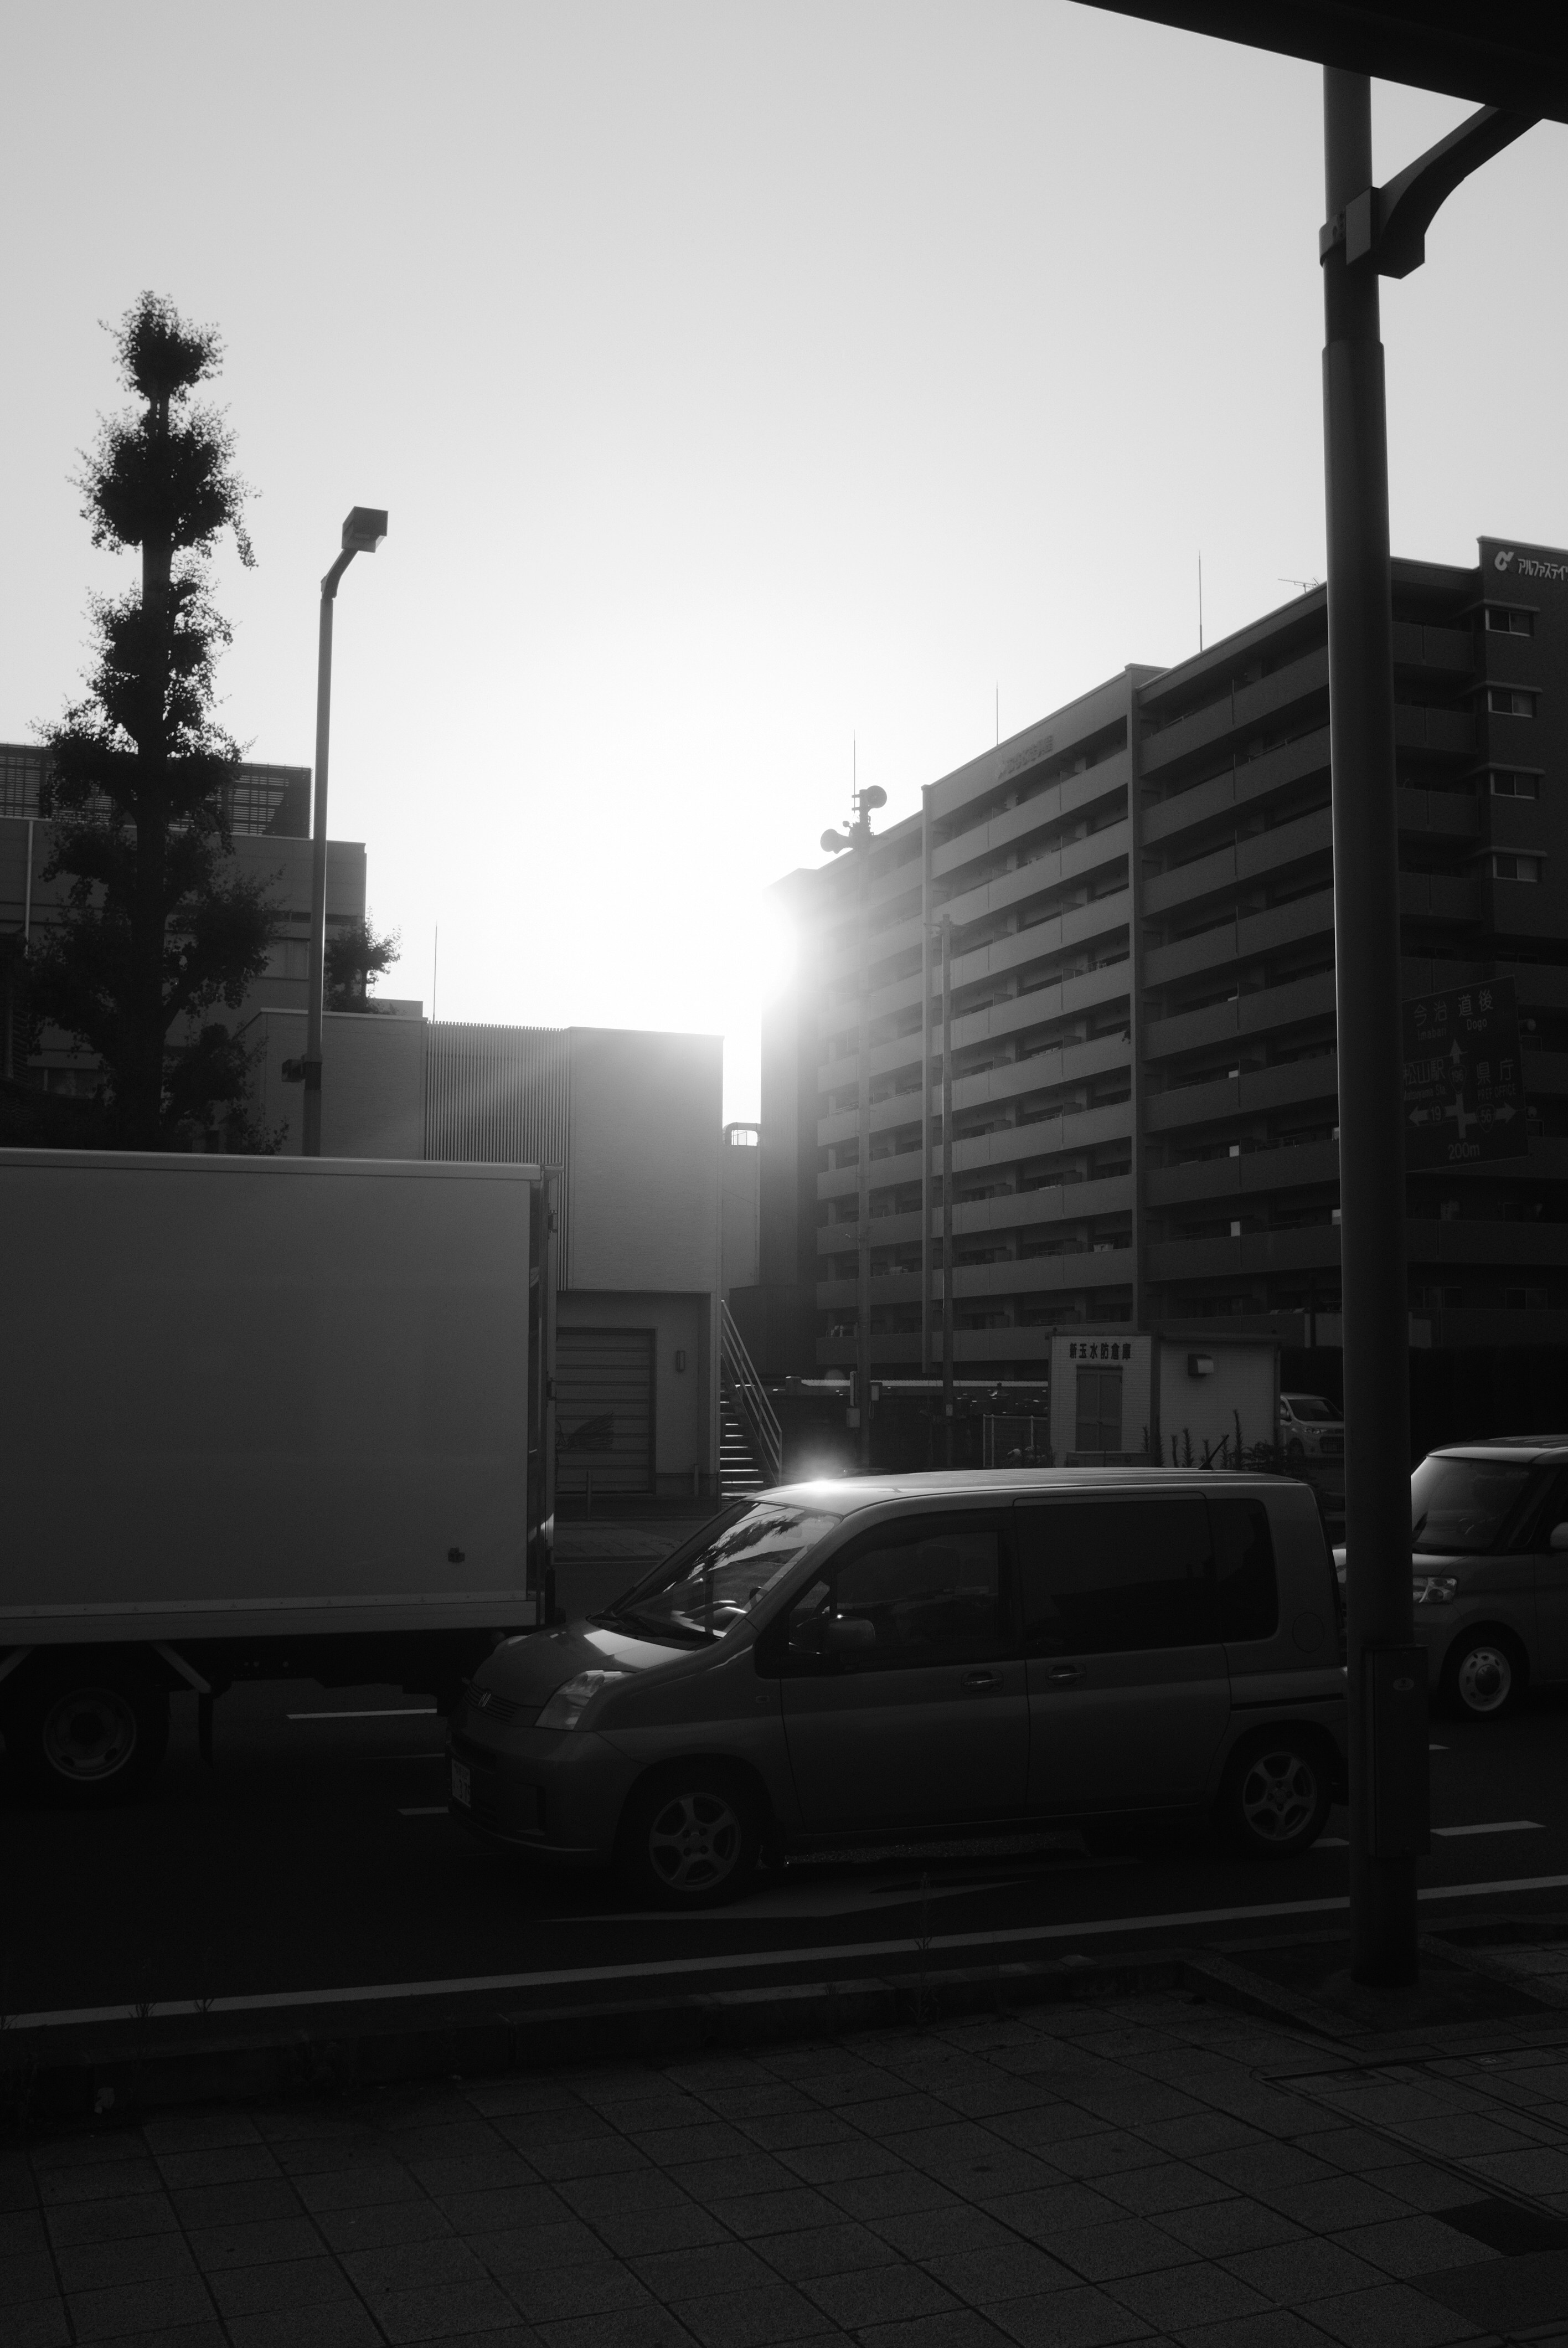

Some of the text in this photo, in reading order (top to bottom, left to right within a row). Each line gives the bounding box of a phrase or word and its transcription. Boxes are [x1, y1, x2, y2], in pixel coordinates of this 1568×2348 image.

[1414, 988, 1494, 1027] 今治 道後
[1417, 1026, 1447, 1041] Imabari
[1466, 1018, 1488, 1032] Dogo
[1403, 1059, 1446, 1087] 松山駅
[1452, 1069, 1464, 1083] 196
[1476, 1058, 1514, 1085] 県庁
[1431, 1105, 1442, 1121] 19
[1480, 1109, 1492, 1124] 56
[1448, 1141, 1481, 1161] 200m
[1069, 1342, 1131, 1360] 新玉水防倉庫
